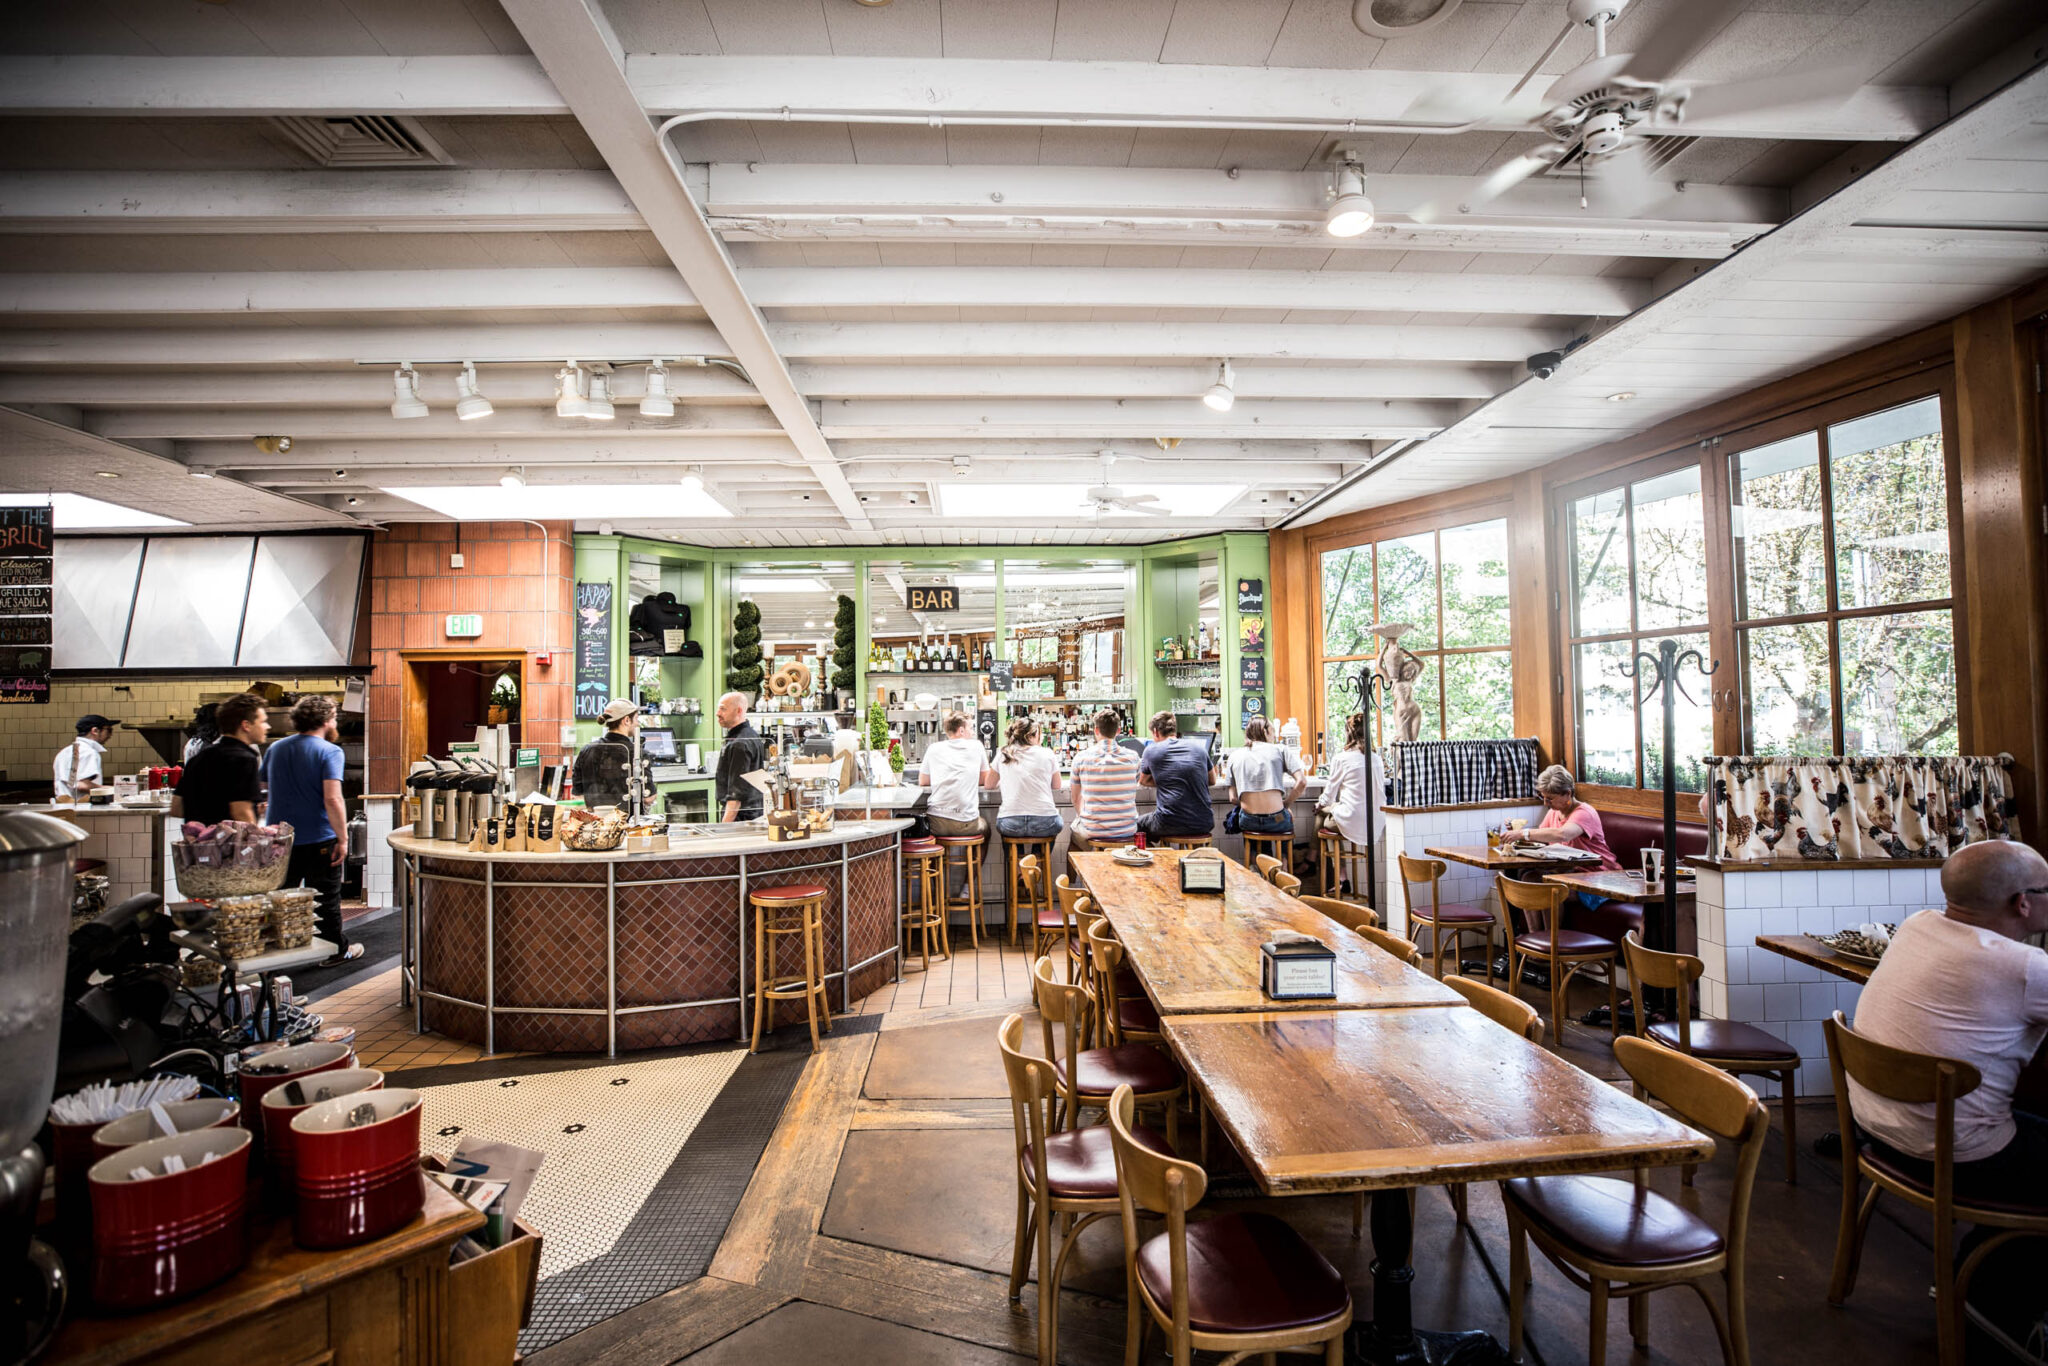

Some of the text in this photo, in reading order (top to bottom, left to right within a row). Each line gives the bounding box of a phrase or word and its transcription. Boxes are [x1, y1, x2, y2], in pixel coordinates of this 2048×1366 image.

[19, 508, 49, 525] THE
[1, 588, 42, 597] GRILLED
[577, 584, 612, 610] HAPPY
[912, 591, 953, 608] BAR
[452, 615, 475, 634] EXIT
[576, 695, 608, 716] HOUR
